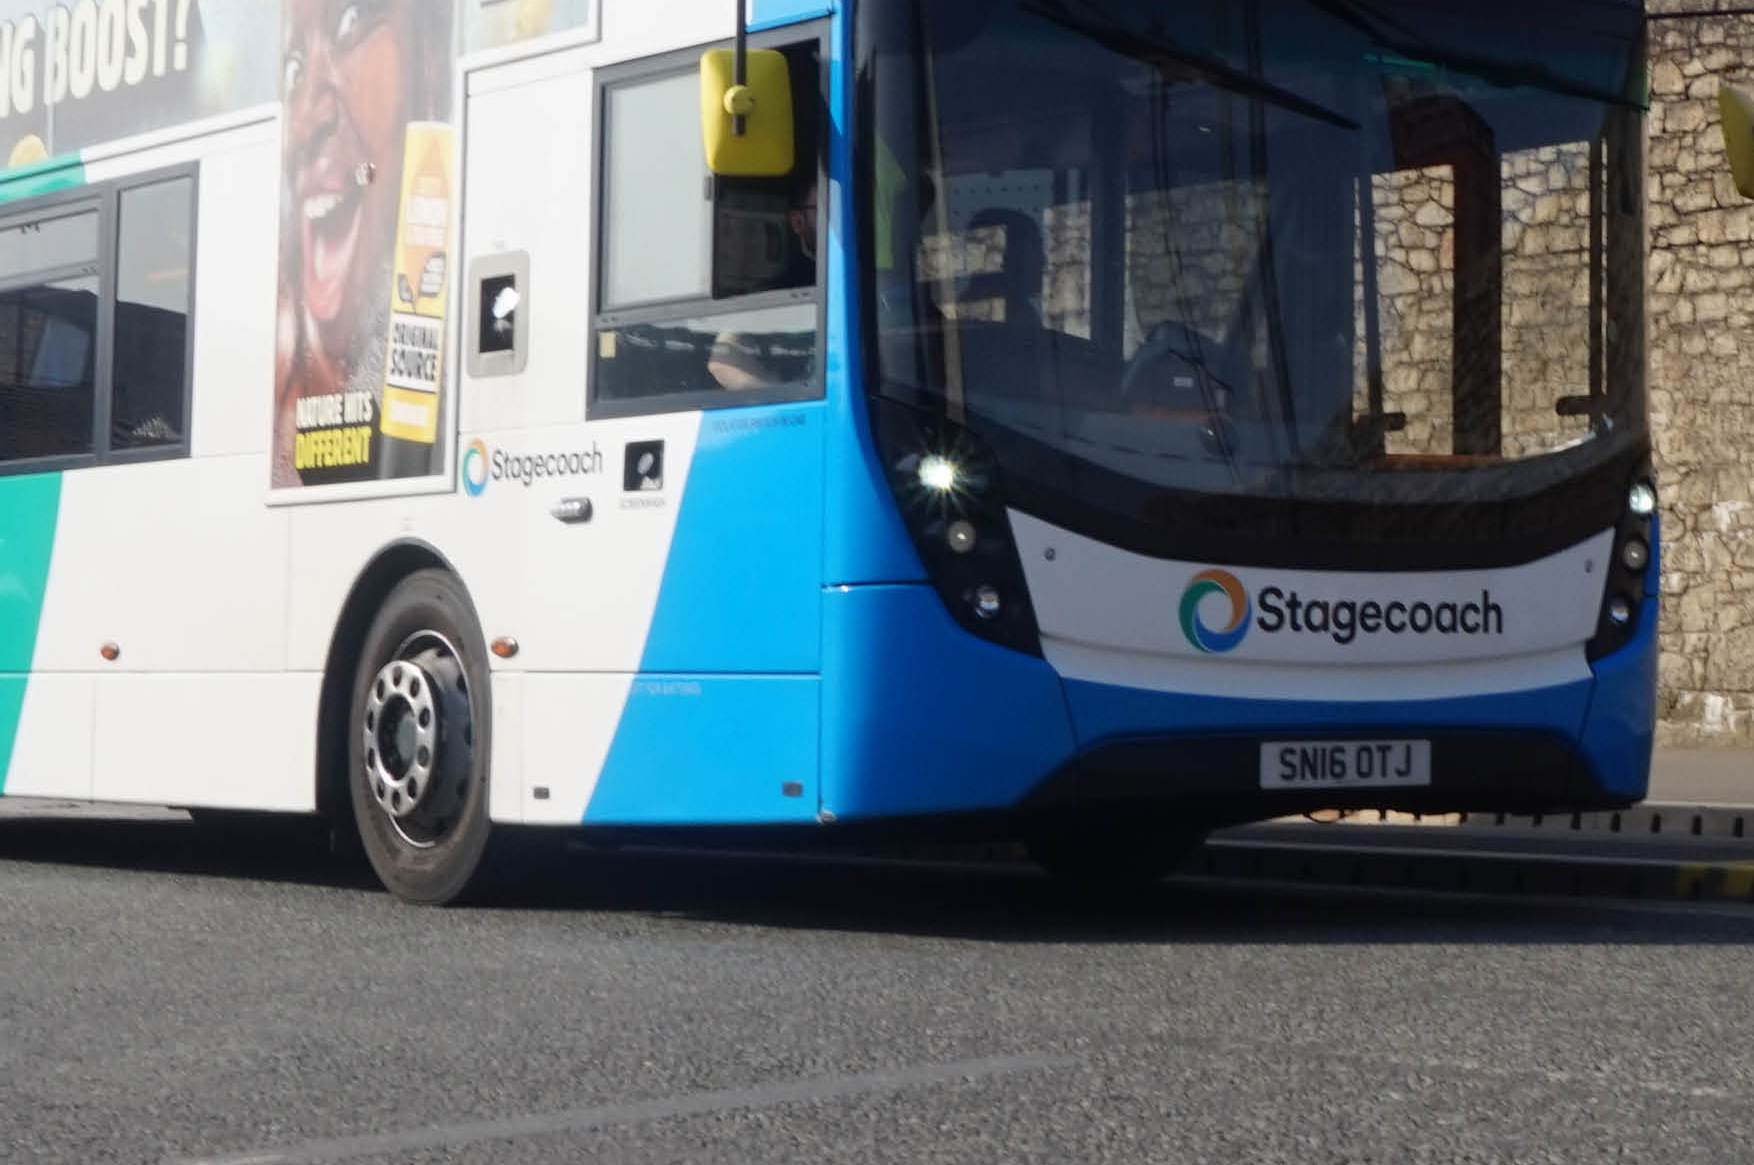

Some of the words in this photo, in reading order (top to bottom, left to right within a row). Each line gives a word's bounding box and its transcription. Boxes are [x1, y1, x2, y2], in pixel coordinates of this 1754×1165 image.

[390, 348, 437, 381] SOURCE
[296, 394, 343, 429] NATURE
[344, 391, 374, 424] HITS
[296, 425, 373, 470] DIFFERENT
[491, 441, 603, 487] Stagecoach
[1256, 585, 1504, 646] Stagecoach
[1278, 745, 1347, 781] SN16
[1355, 743, 1413, 779] OTJ
